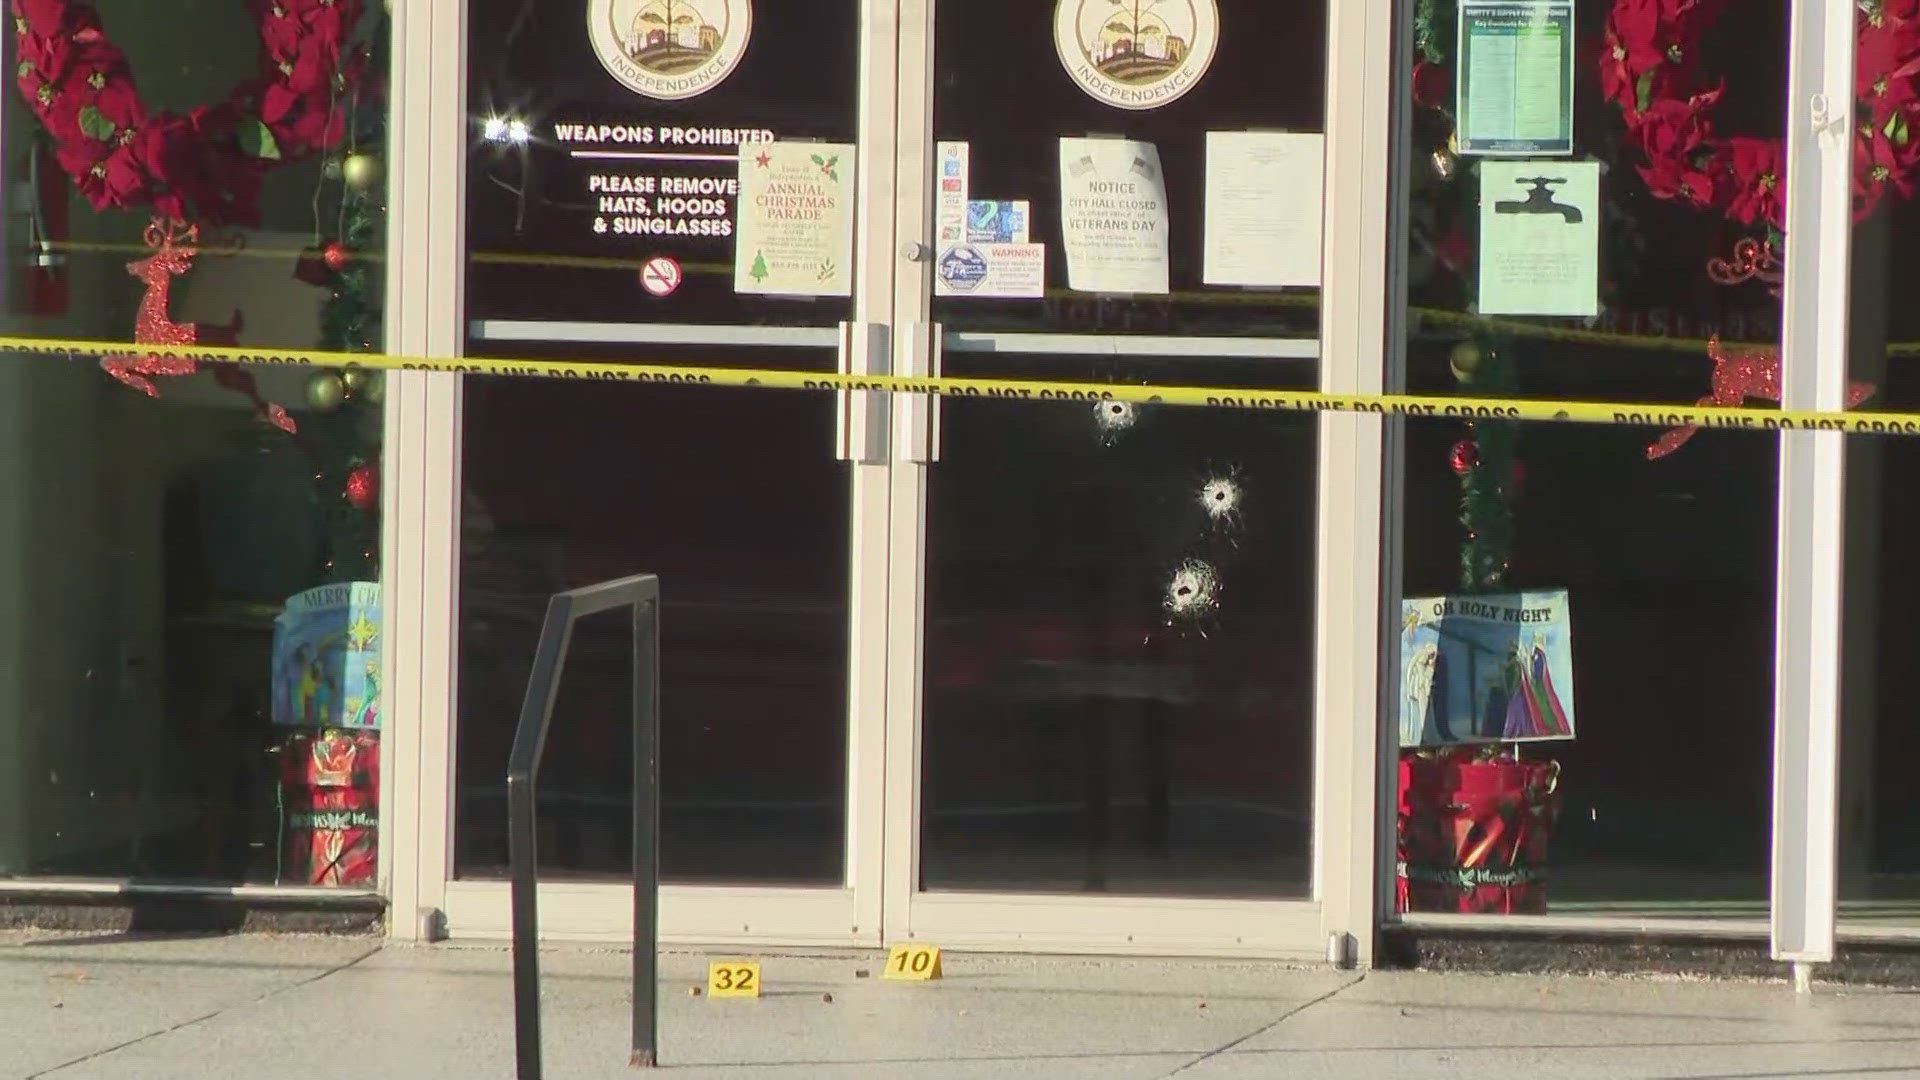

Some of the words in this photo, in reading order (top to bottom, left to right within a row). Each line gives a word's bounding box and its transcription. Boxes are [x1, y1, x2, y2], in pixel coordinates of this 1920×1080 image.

[611, 54, 728, 92] INDEPENDENCE
[1077, 64, 1195, 102] INDEPENDENCE
[555, 124, 653, 144] WEAPONS
[659, 127, 775, 146] PROHIBITED
[589, 175, 656, 194] PLEASE
[661, 177, 739, 196] REMOVE
[767, 182, 826, 197] ANNUAL
[1088, 181, 1136, 195] NOTICE
[600, 196, 652, 216] HATS,
[657, 199, 726, 216] HOODS
[755, 195, 836, 209] CHRISTMAS
[1069, 199, 1089, 209] CITY
[1092, 199, 1116, 209] HALL
[1119, 199, 1157, 211] CLOSED
[767, 207, 823, 221] PARADE
[593, 217, 608, 233] &
[613, 217, 732, 237] SUNGLASSES
[1069, 218, 1128, 232] VETERANS
[1131, 220, 1157, 232] DAY
[992, 248, 1041, 258] WARNING
[304, 585, 351, 610] MERRY
[1432, 600, 1454, 617] OH
[1459, 601, 1500, 620] HOLY
[1503, 607, 1552, 623] NIGHT
[895, 950, 930, 973] 10
[715, 968, 754, 991] 32
